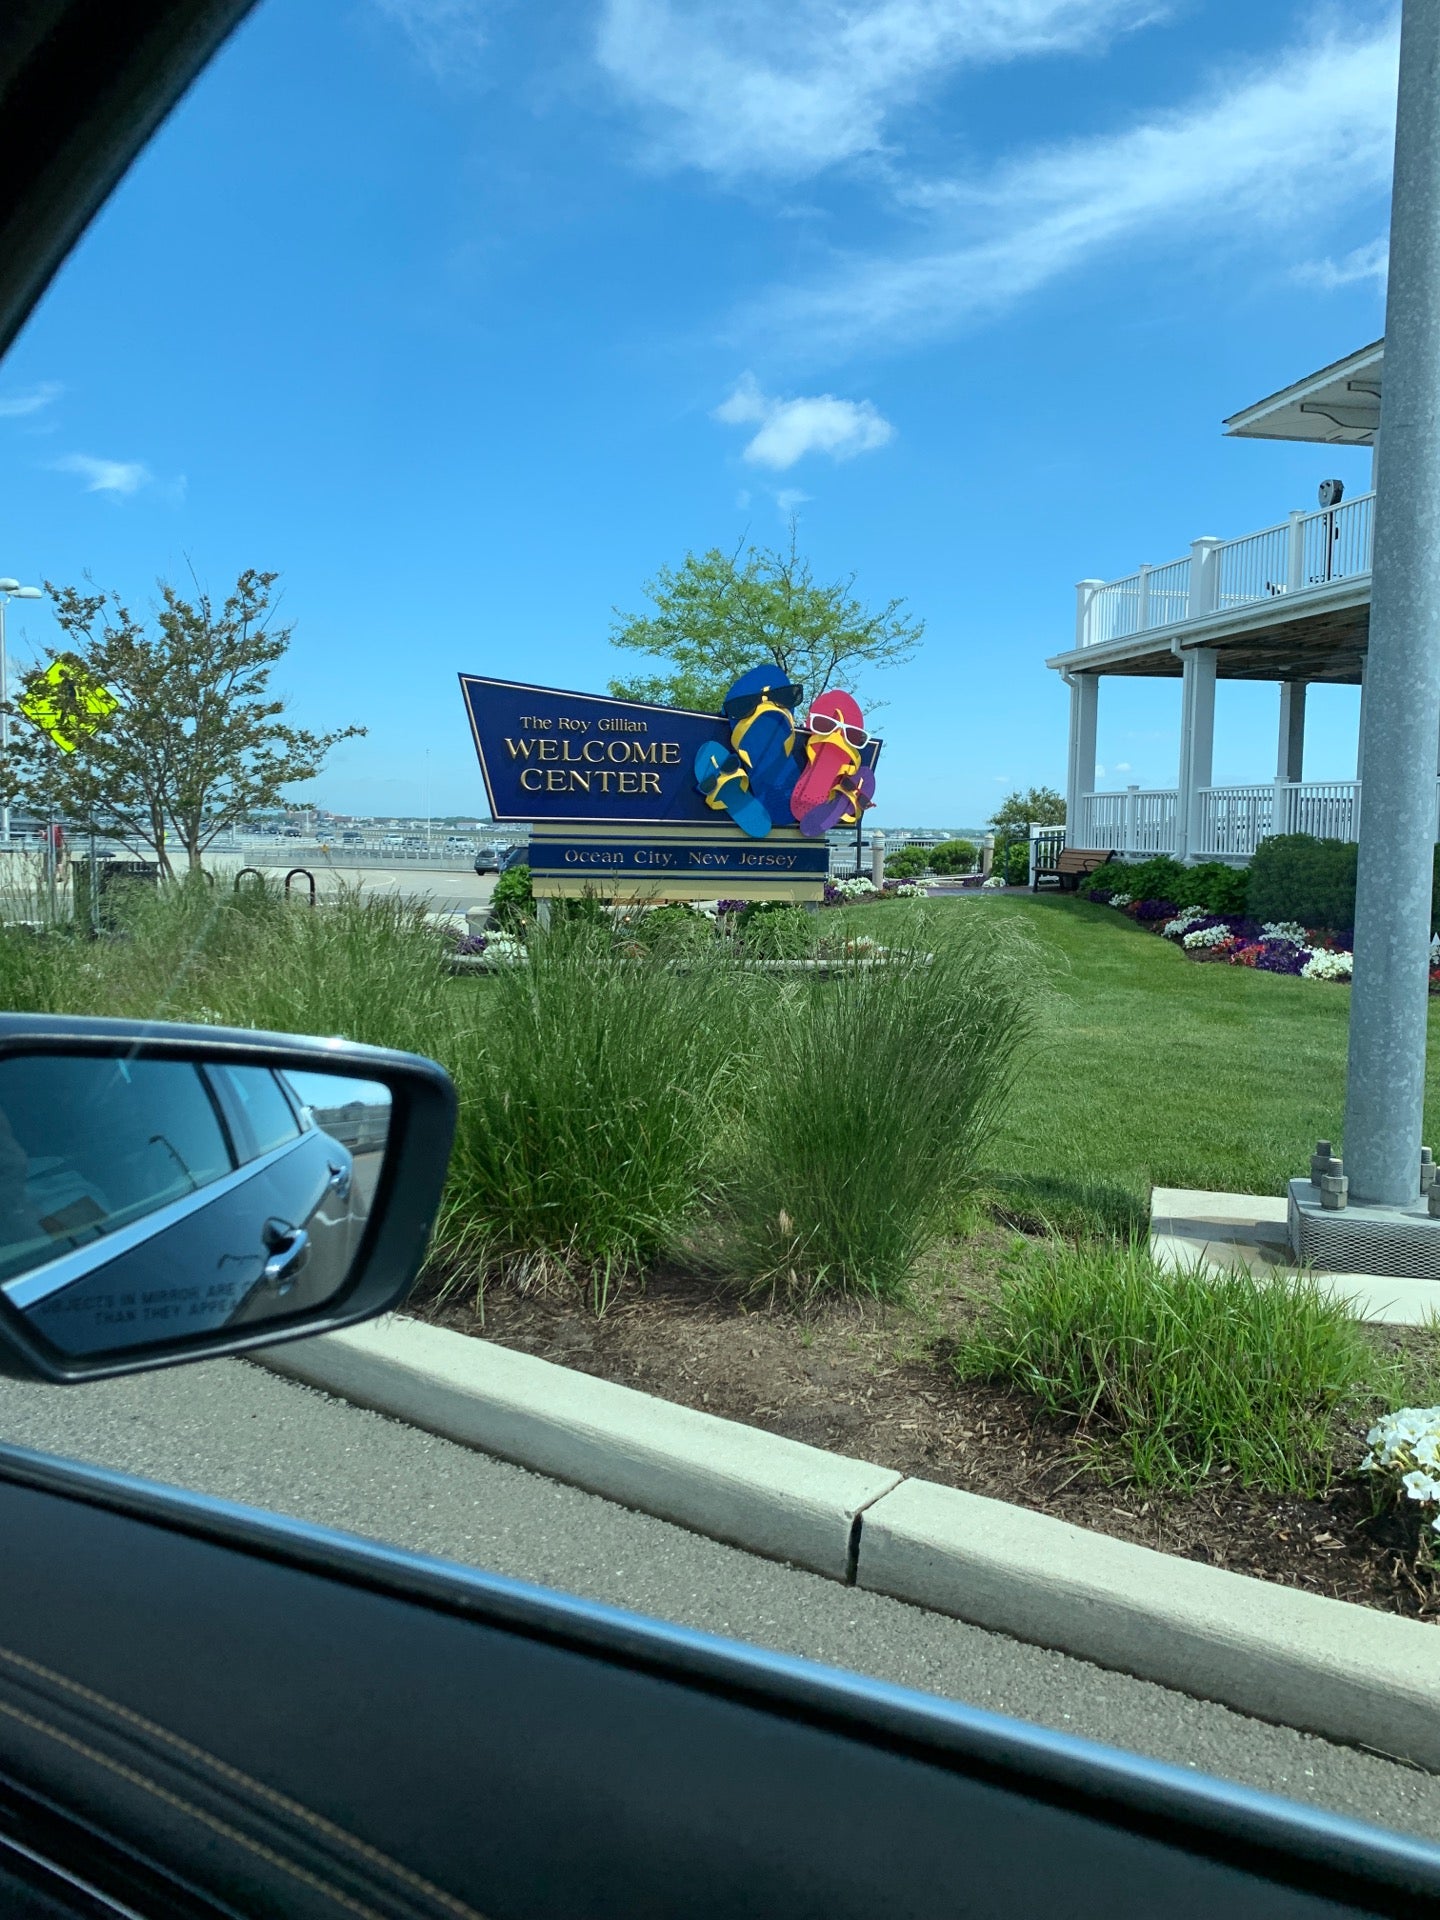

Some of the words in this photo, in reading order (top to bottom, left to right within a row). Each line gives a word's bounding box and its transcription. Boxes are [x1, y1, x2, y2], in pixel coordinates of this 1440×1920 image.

[520, 716, 552, 730] The
[558, 717, 591, 733] Roy
[598, 718, 648, 732] Gillian
[504, 738, 681, 764] WELCOME
[520, 768, 662, 794] CENTER
[564, 849, 624, 864] Ocean
[634, 850, 677, 866] City,
[689, 851, 730, 864] New
[739, 852, 798, 869] Jersey
[141, 1287, 199, 1305] MIRROR
[207, 1283, 234, 1298] ARE
[95, 1310, 135, 1325] THAN
[144, 1305, 179, 1320] THEY
